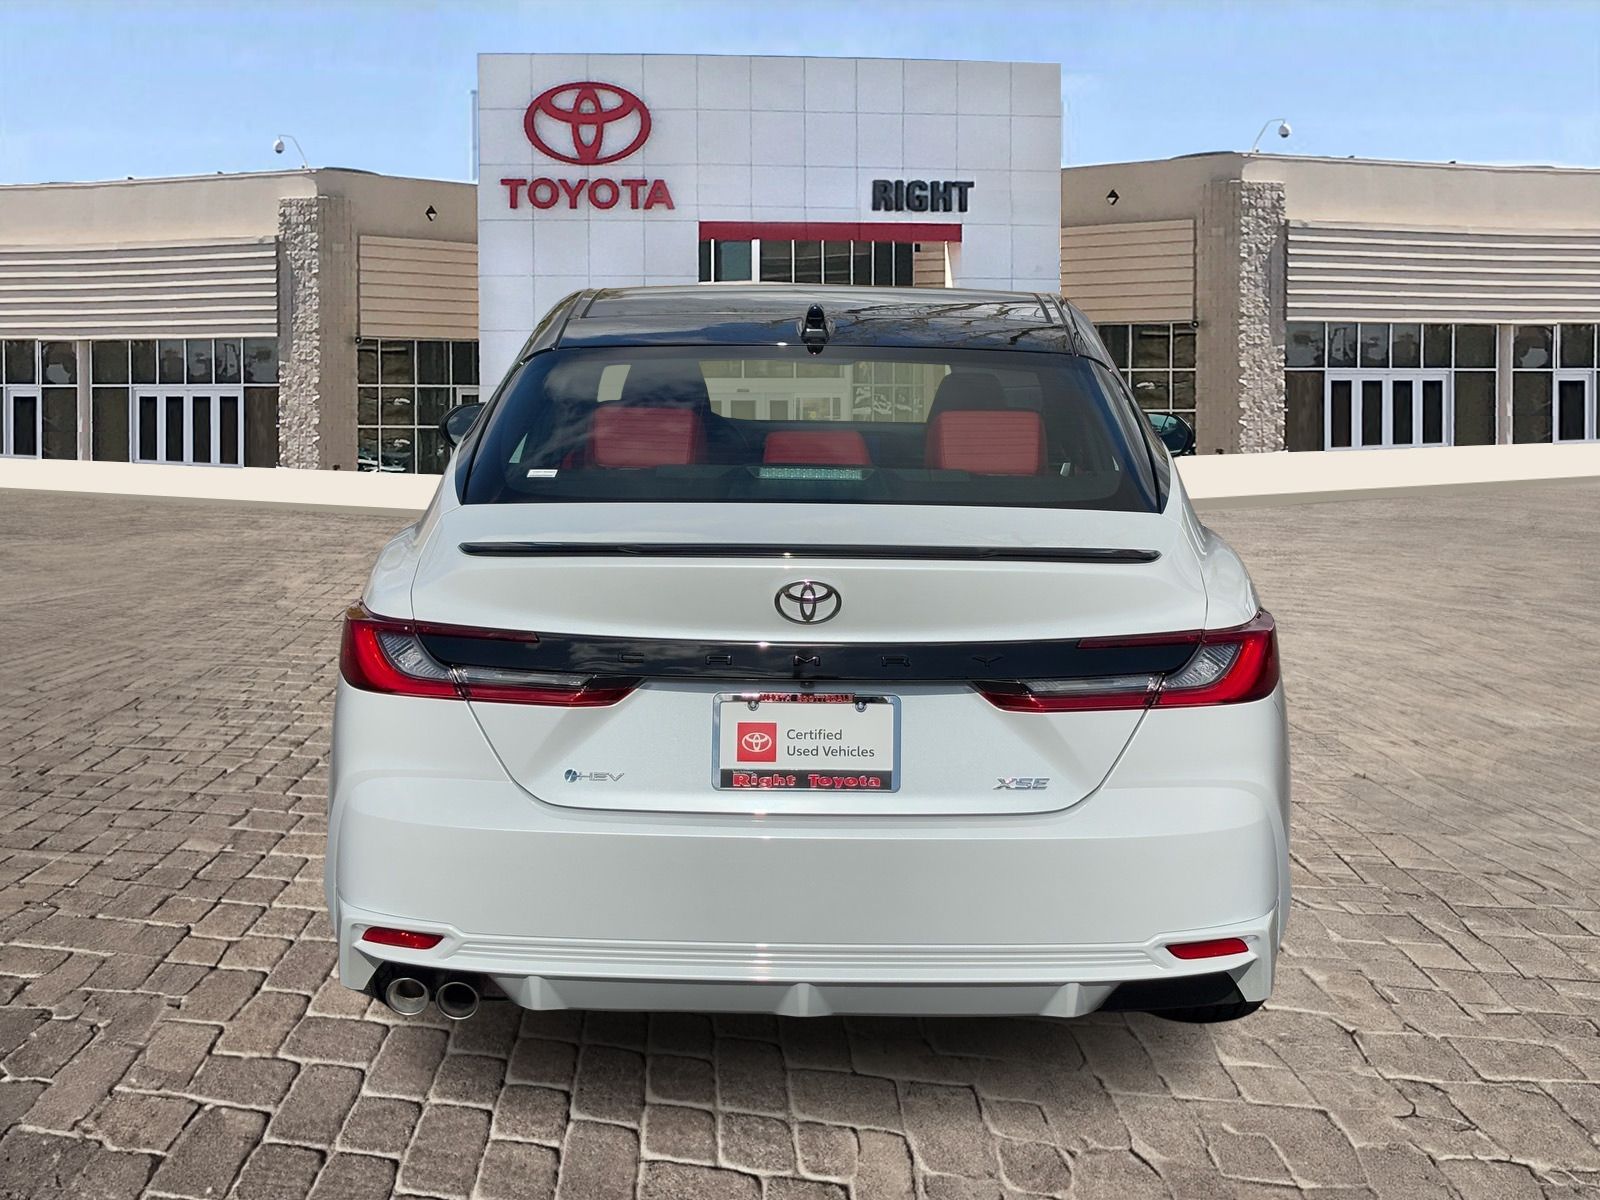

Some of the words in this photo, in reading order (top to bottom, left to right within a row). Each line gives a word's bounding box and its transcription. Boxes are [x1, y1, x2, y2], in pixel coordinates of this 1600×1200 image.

[500, 178, 675, 210] TOYOTA
[871, 178, 975, 213] RIGHT
[616, 651, 1004, 669] CAMRY
[786, 729, 843, 741] Certified
[786, 745, 819, 757] Used
[823, 745, 875, 757] Vehicles
[732, 772, 796, 788] Right
[807, 773, 881, 788] Toyota
[992, 777, 1050, 790] XSE
